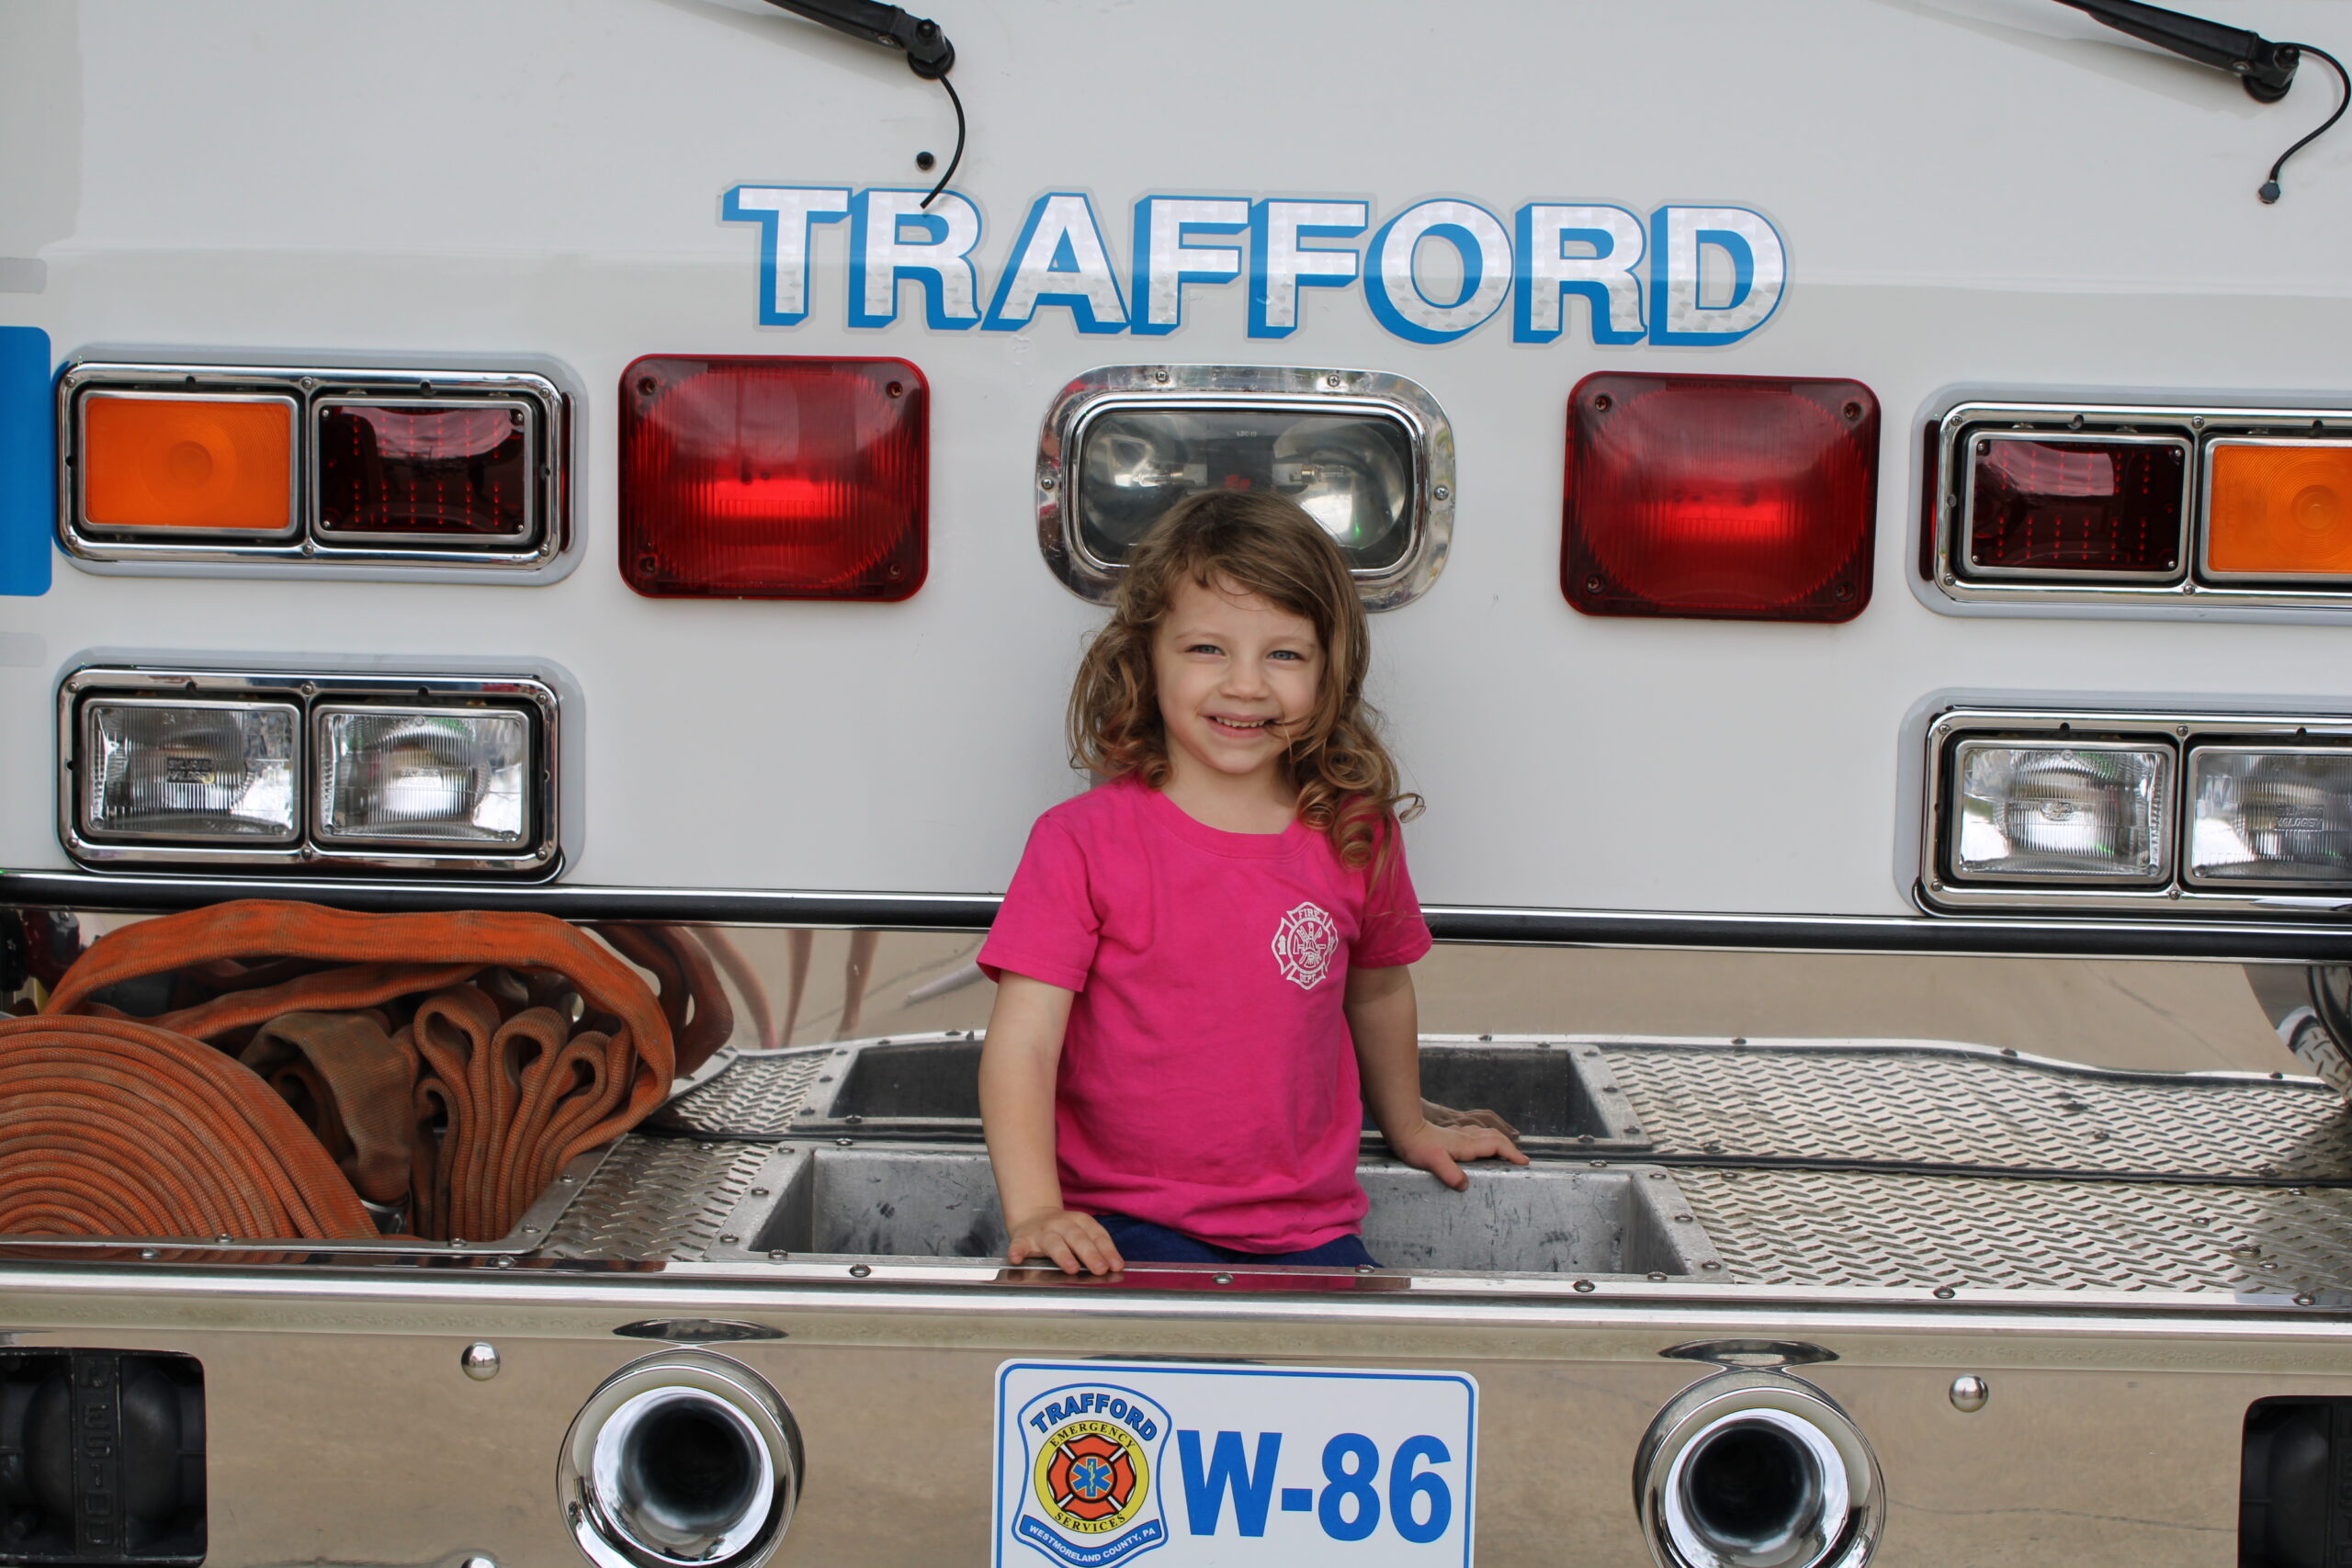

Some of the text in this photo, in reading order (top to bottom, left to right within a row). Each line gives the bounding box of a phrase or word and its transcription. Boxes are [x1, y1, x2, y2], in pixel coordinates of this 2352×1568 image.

[722, 184, 1787, 347] TRAFFORD
[1298, 908, 1321, 919] FIRE
[1030, 1393, 1158, 1442] TRAFFORD
[1049, 1422, 1136, 1449] EMERGENCY
[1177, 1429, 1453, 1544] W-86
[1054, 1512, 1126, 1532] SERVICES
[1029, 1524, 1157, 1562] WESTMORELAND COUNTY, PA
